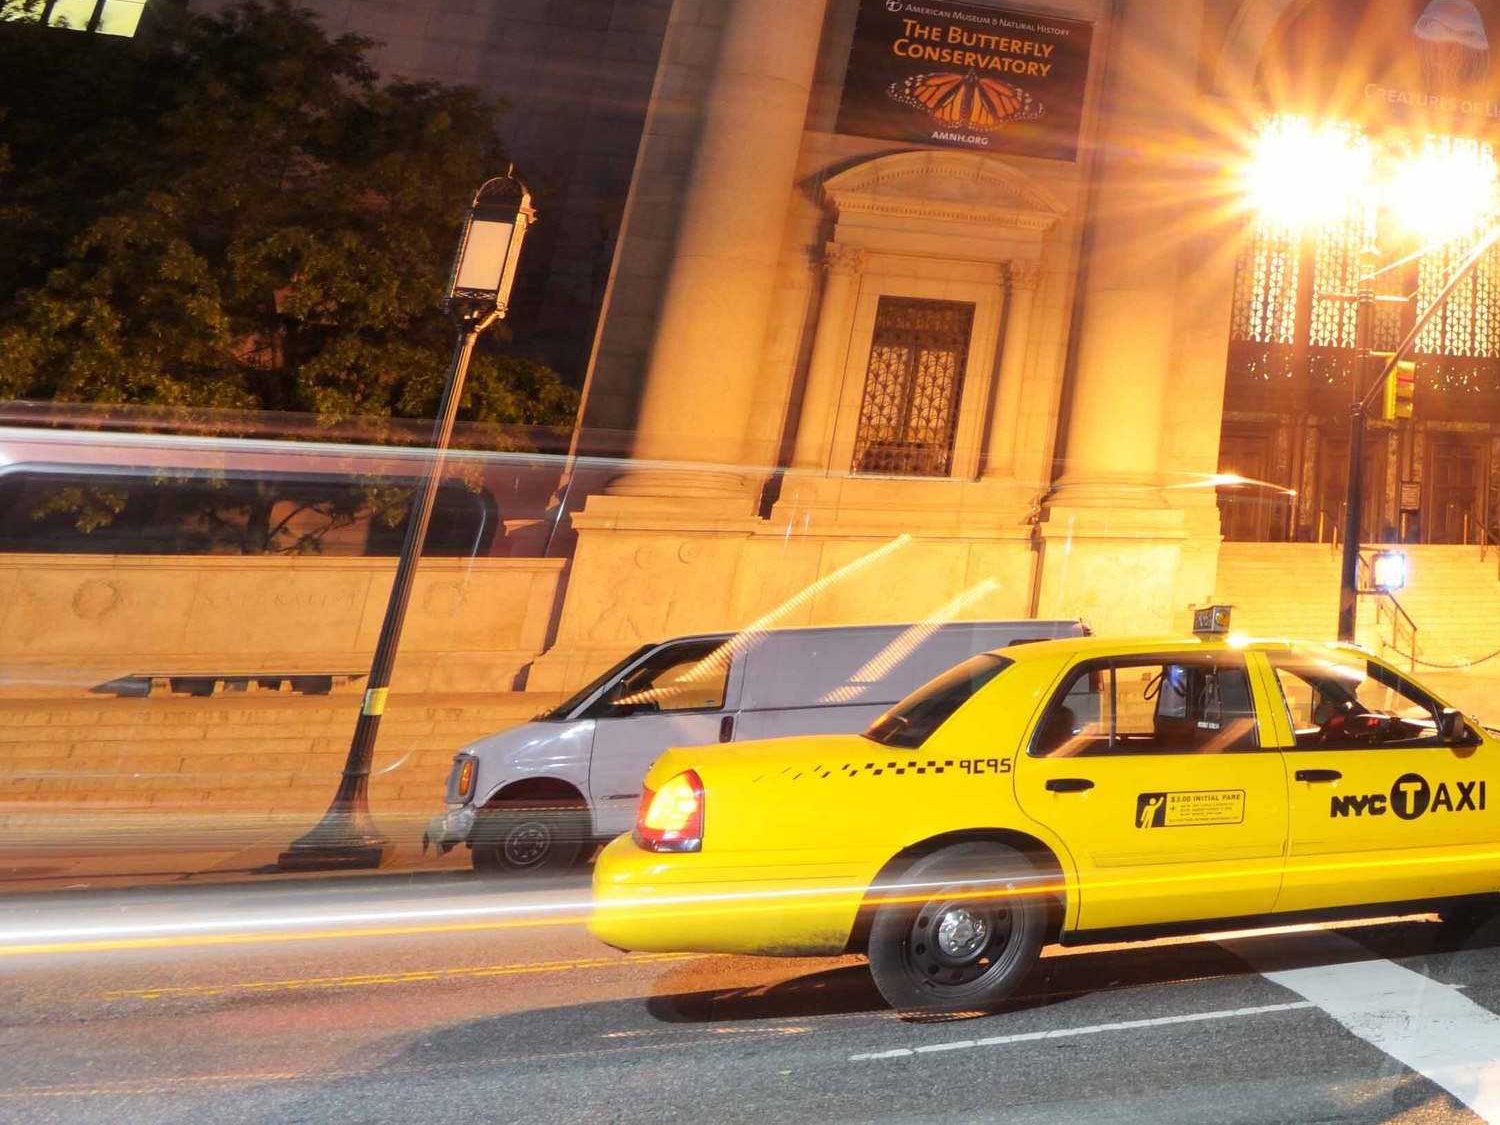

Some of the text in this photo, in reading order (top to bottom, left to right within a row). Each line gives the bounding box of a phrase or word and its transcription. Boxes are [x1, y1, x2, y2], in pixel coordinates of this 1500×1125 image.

[904, 3, 951, 18] AMERICAN
[952, 11, 991, 25] MUSEUM
[999, 18, 1035, 32] NATURAL
[1036, 25, 1071, 37] HISTORY
[902, 18, 1055, 59] THE BUTTERFLY
[892, 39, 1053, 77] CONSERVATORY
[1364, 83, 1458, 112] CREATURES
[1460, 100, 1483, 114] OF
[931, 130, 989, 146] AMNH.ORG
[959, 758, 1011, 775] 9C95
[1330, 778, 1486, 818] NYC TAXI
